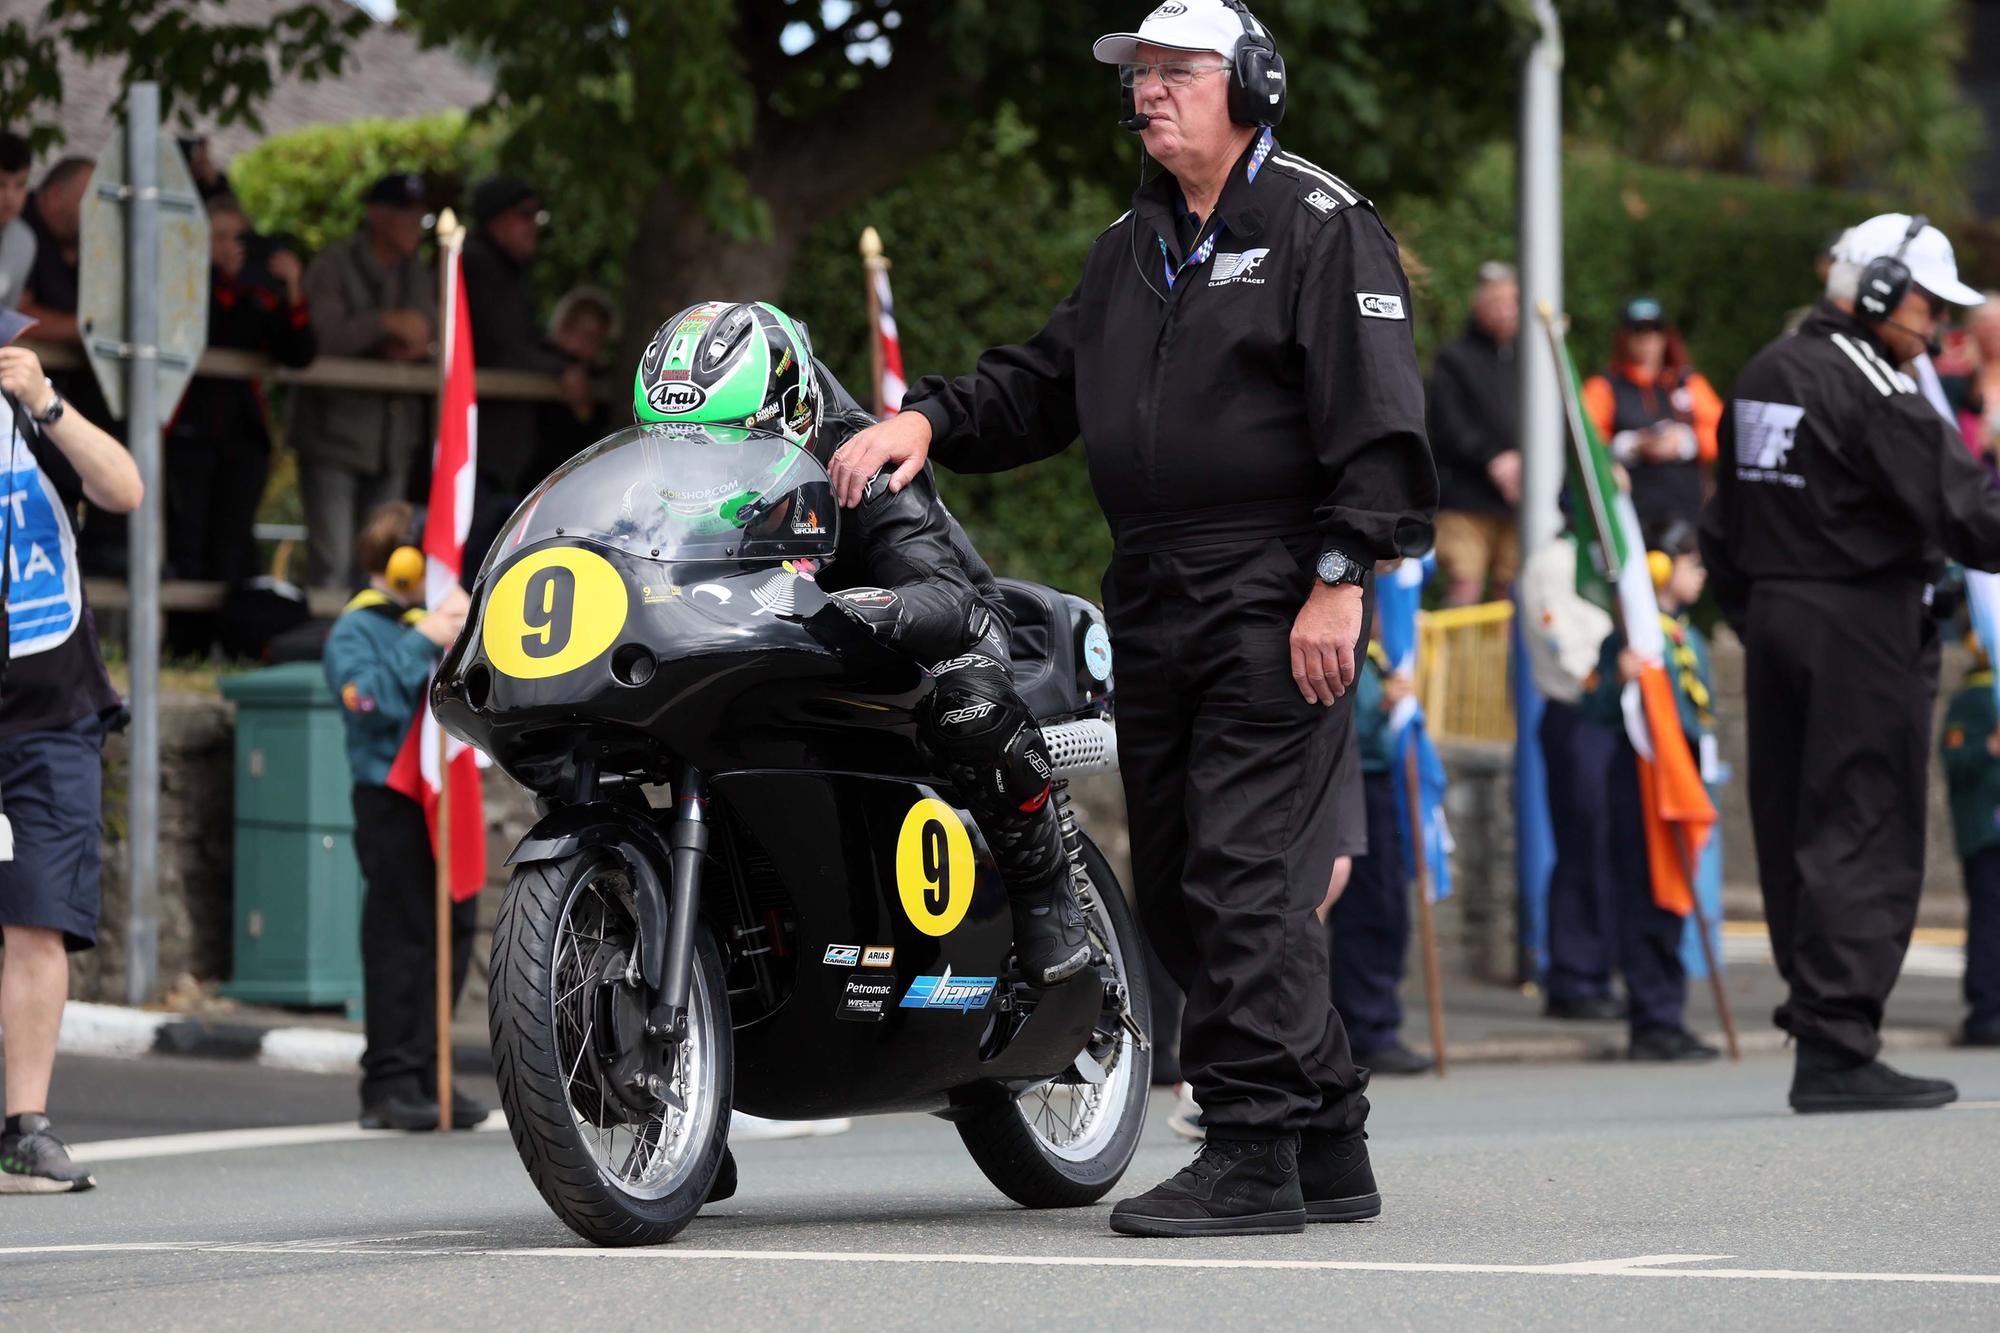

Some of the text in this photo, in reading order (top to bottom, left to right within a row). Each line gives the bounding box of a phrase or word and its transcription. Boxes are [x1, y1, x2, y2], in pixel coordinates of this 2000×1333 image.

[1308, 191, 1336, 210] OMP
[650, 386, 698, 405] Arai
[755, 401, 780, 418] OMAH
[521, 565, 576, 659] 9
[940, 701, 998, 726] RST
[1023, 749, 1052, 780] RST
[922, 818, 950, 917] 9
[824, 957, 856, 965] CARRILLO
[867, 951, 890, 960] ARIAS
[846, 982, 891, 995] Petromac
[847, 999, 883, 1008] WIRELINE
